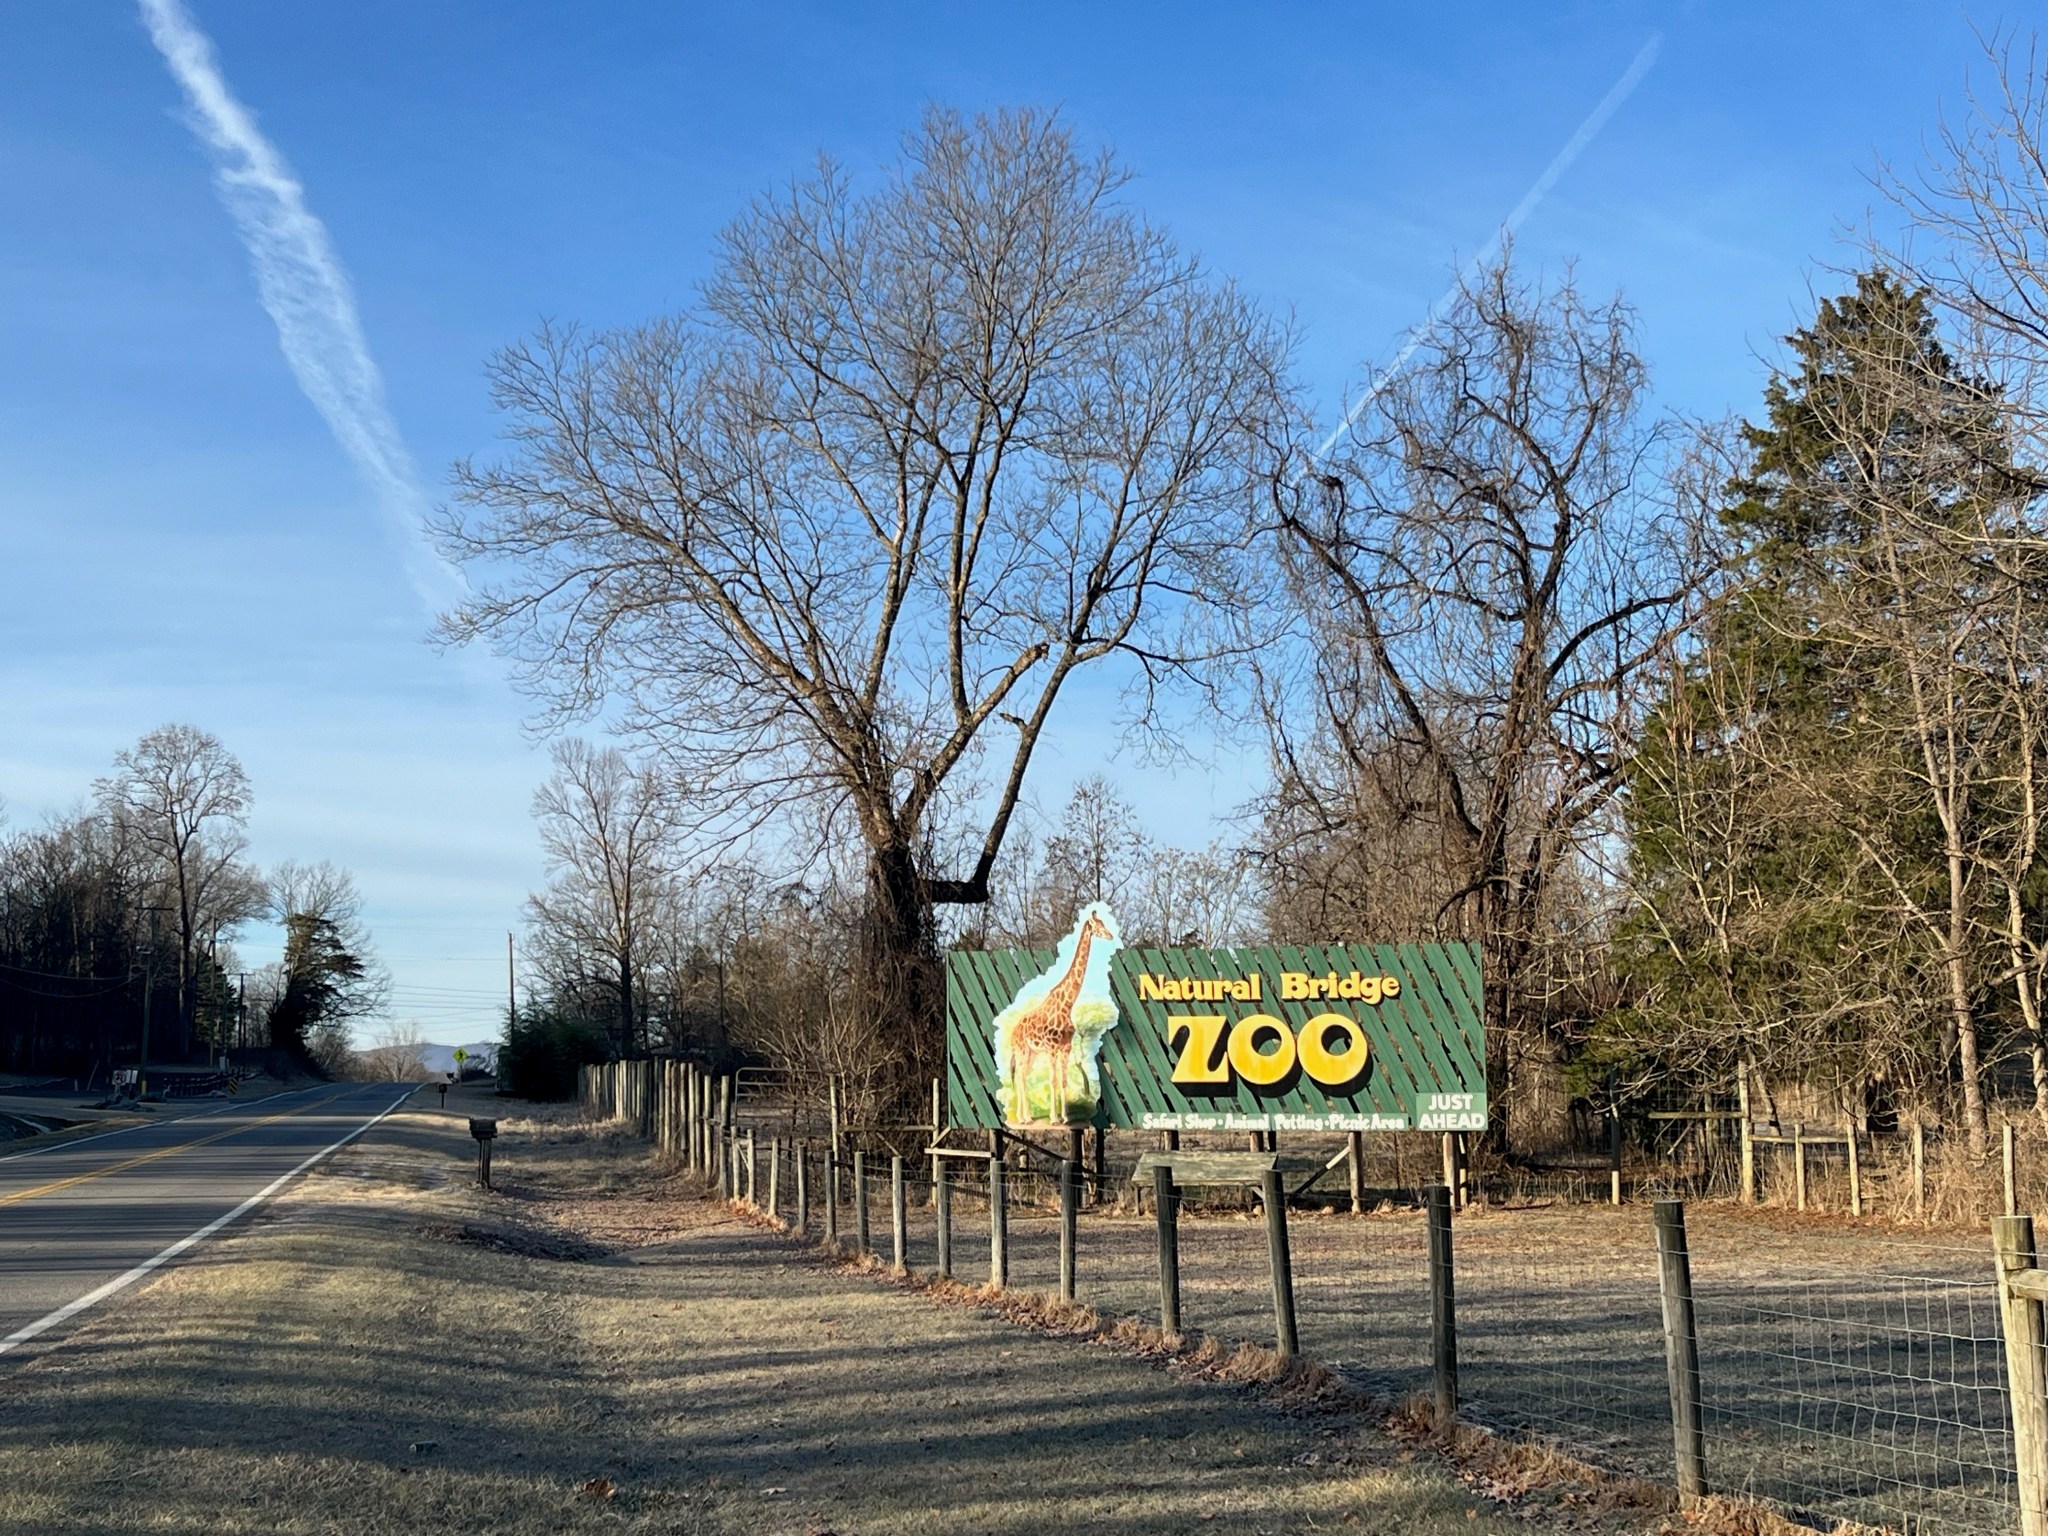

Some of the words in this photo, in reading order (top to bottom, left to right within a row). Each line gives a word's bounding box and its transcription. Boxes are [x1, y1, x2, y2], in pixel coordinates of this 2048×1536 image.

[1139, 973, 1261, 1000] Natural
[1281, 970, 1400, 1004] Bridge
[1168, 1013, 1367, 1085] ZOO
[1428, 1094, 1473, 1110] JUST
[1142, 1113, 1183, 1129] Safari
[1225, 1113, 1270, 1130] Animal
[1328, 1113, 1370, 1130] Picnic
[1371, 1113, 1405, 1130] Area
[1419, 1113, 1485, 1129] AHEAD
